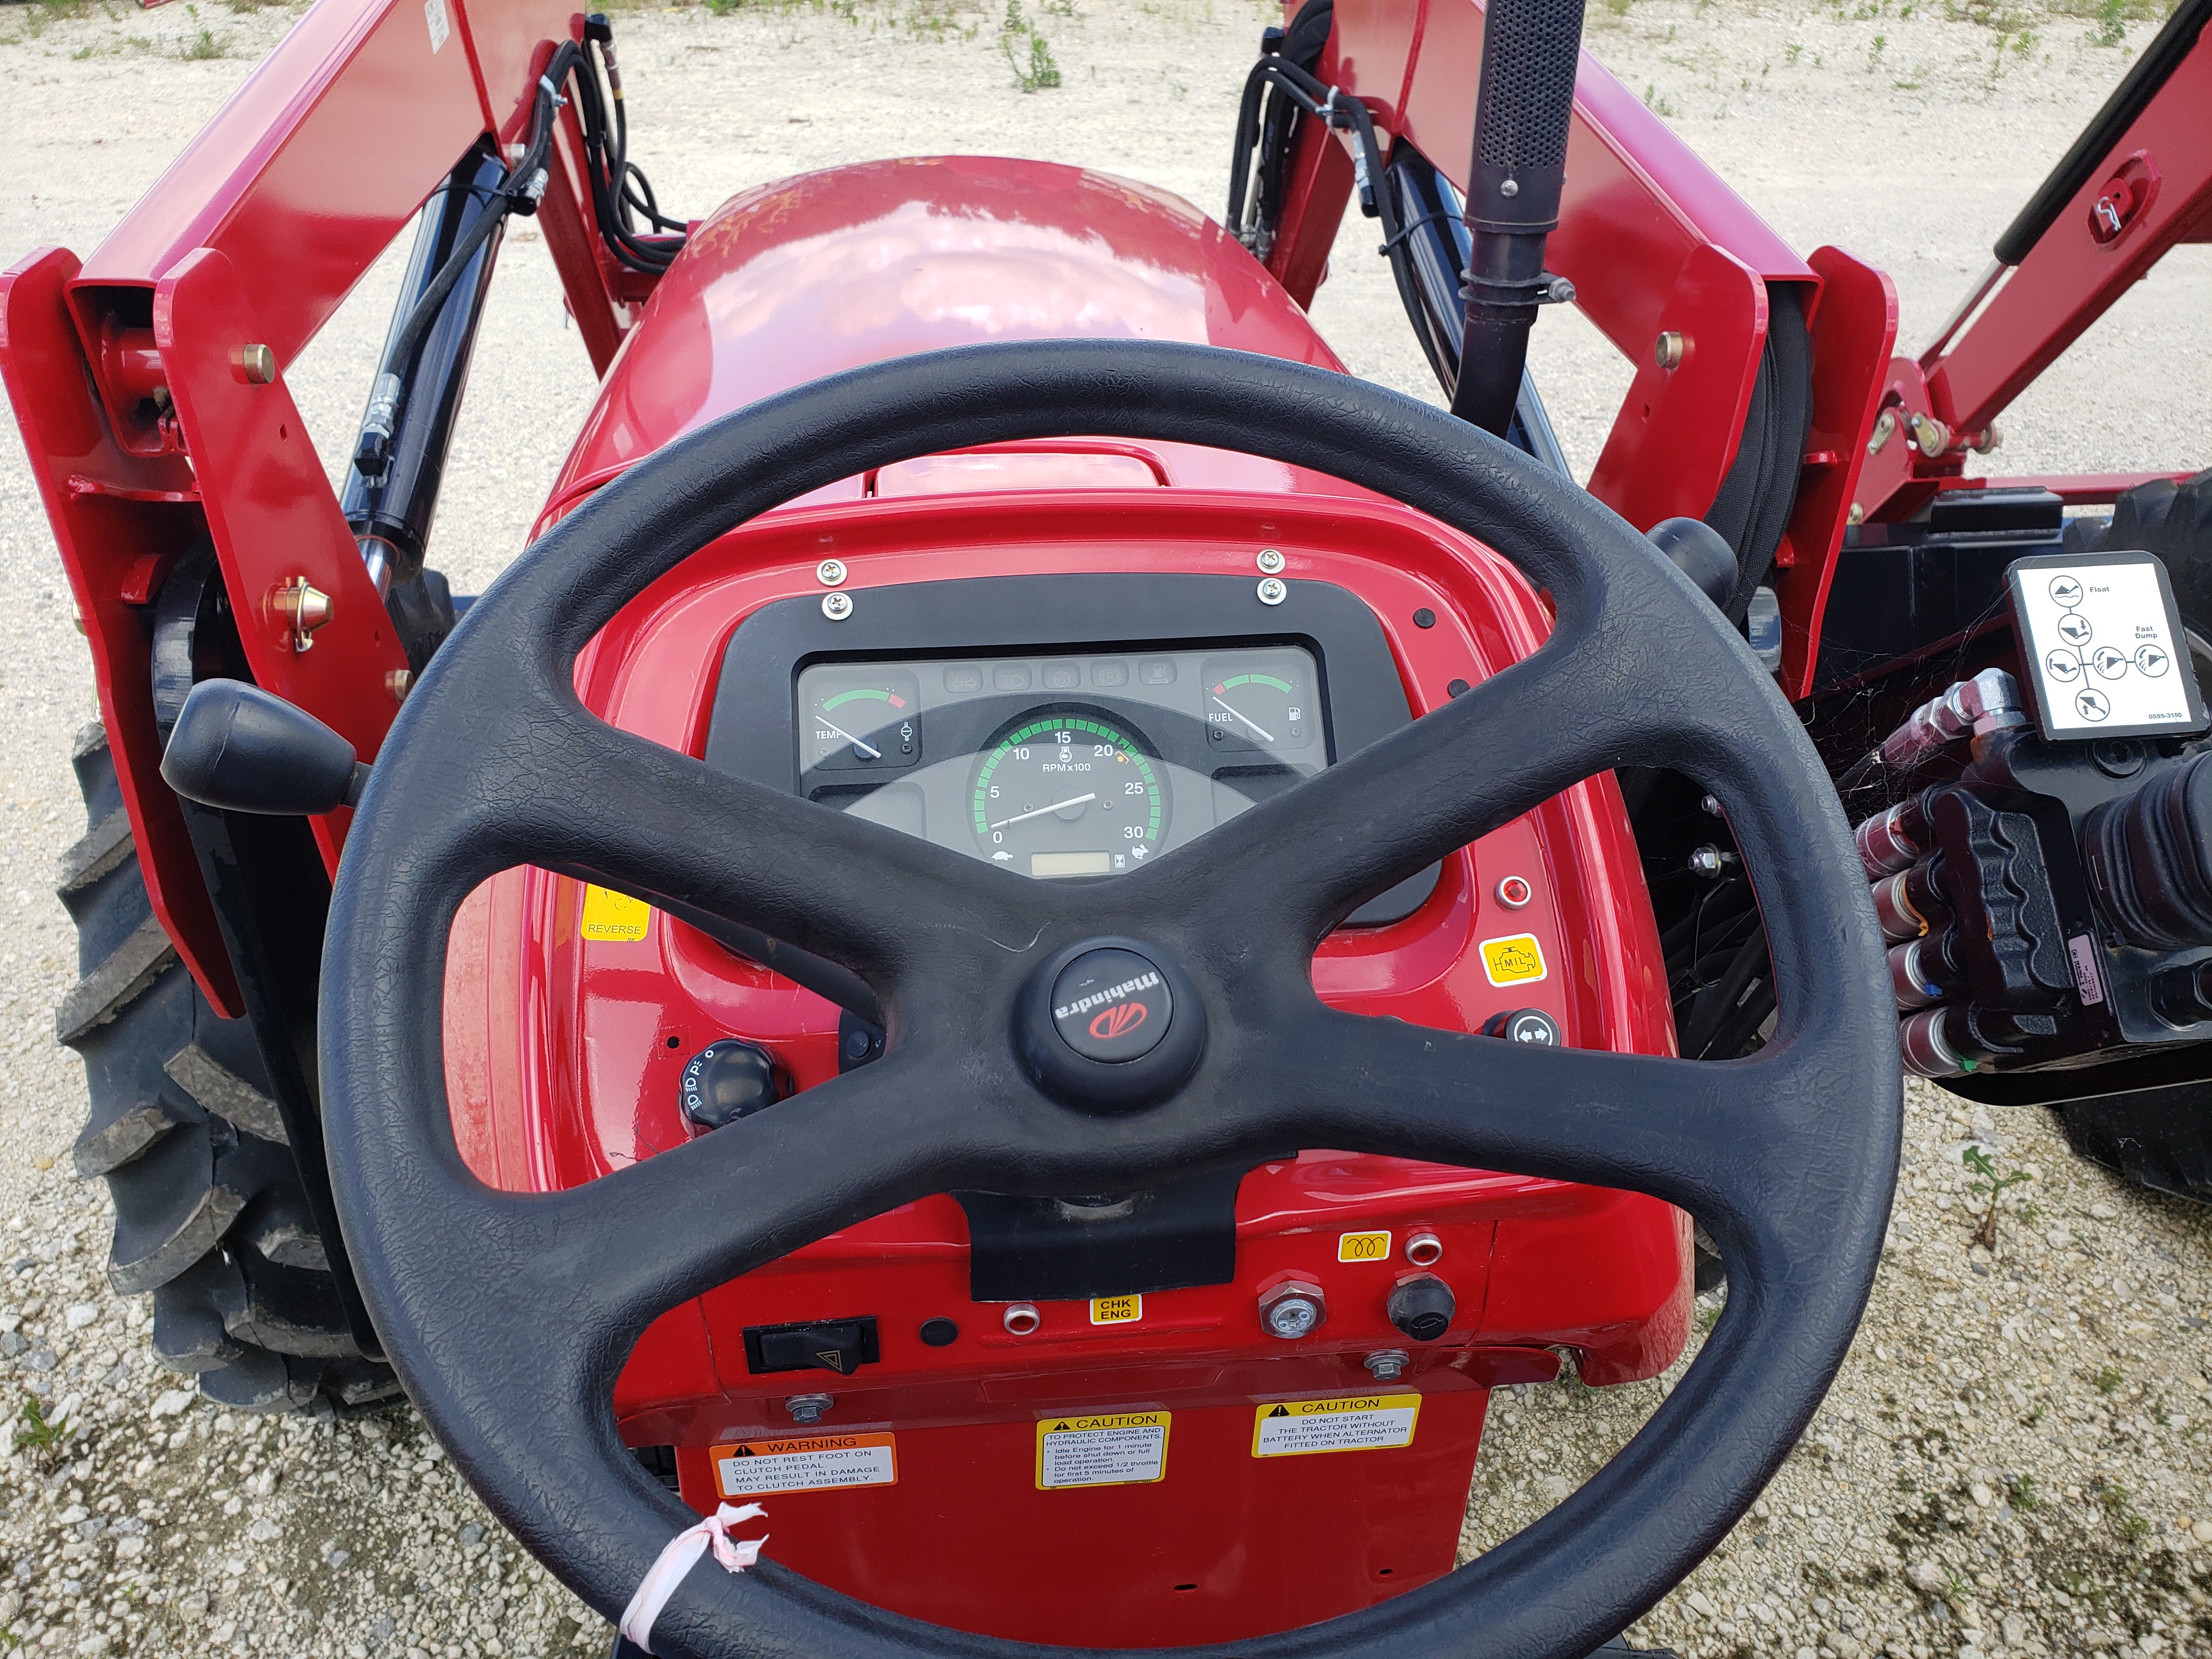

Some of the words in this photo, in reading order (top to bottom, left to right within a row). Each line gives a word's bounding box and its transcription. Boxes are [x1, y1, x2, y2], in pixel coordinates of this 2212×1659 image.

[1209, 713, 1233, 722] FUEL
[1054, 732, 1071, 743] 15
[1013, 748, 1029, 760] 10
[1093, 744, 1113, 757] 20
[990, 786, 1000, 798] 5
[1125, 782, 1143, 794] 25
[993, 831, 1002, 843] 0
[1124, 826, 1143, 839] 30
[588, 924, 641, 934] REVERSE
[1504, 957, 1526, 967] MIL
[1054, 972, 1159, 1019] Mahindra
[1101, 1299, 1131, 1309] CHK
[1101, 1310, 1131, 1319] ENG
[1302, 1399, 1379, 1412] CAUTION
[1076, 1415, 1157, 1429] CAUTION
[1350, 1420, 1396, 1429] WITHOUT
[1046, 1438, 1096, 1446] HYDRAULIC
[1098, 1434, 1162, 1442] COMPONENTS.
[1263, 1434, 1308, 1442] BATTERY
[1342, 1427, 1407, 1437] ALTERNATOR
[767, 1437, 856, 1452] WARNING
[734, 1466, 781, 1475] CLUTCH
[765, 1472, 810, 1481] RESULT
[831, 1466, 880, 1475] DAMAGE
[757, 1481, 803, 1489] CLUTCH
[809, 1475, 873, 1485] ASSEMBLY.
